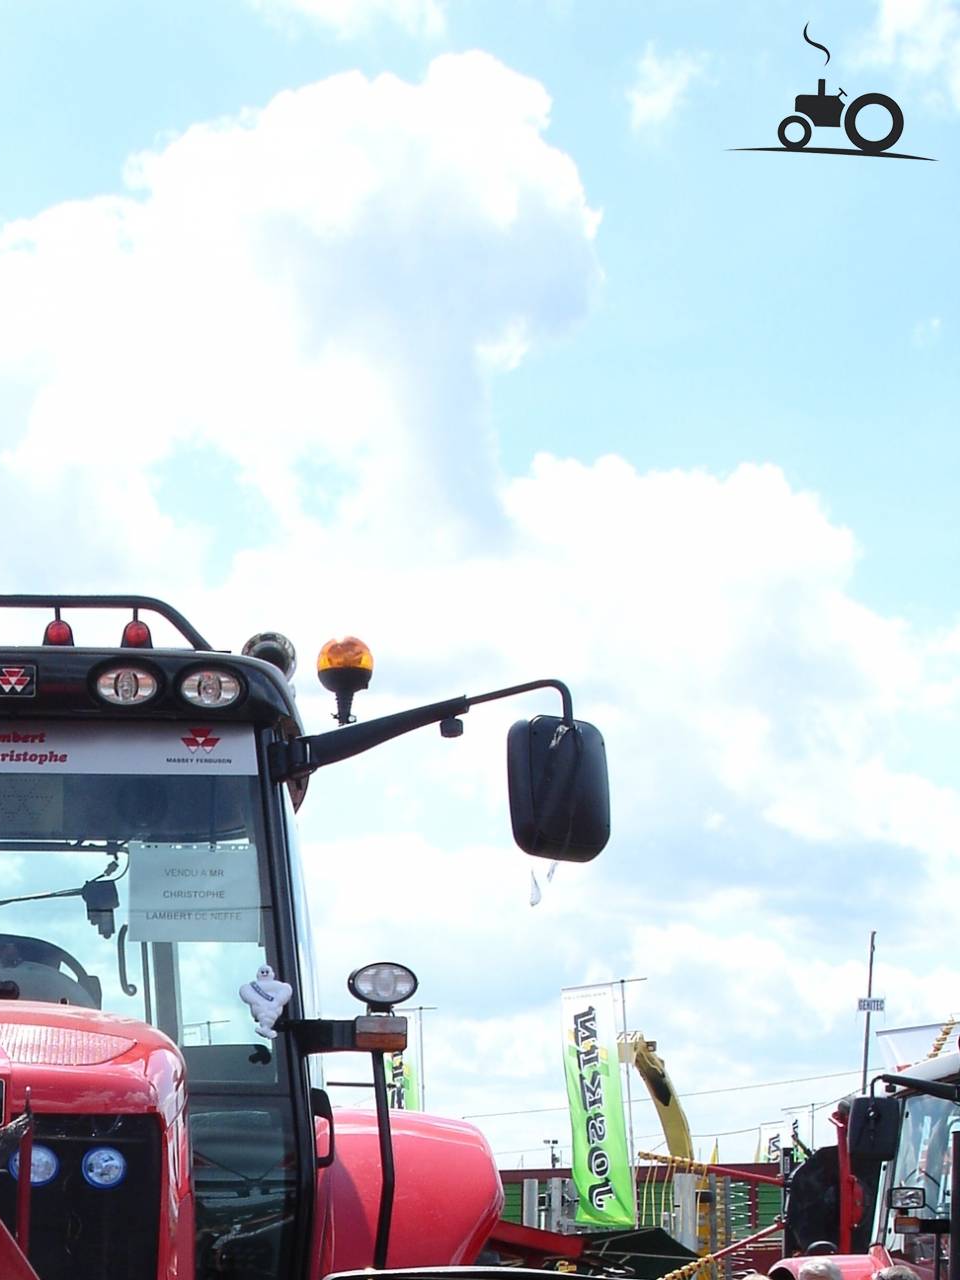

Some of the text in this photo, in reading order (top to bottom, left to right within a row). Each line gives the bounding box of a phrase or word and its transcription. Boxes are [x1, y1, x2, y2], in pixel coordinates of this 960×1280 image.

[164, 868, 199, 878] VENDU
[209, 869, 225, 878] MR
[162, 890, 225, 899] CHRISTOPHE
[145, 912, 193, 921] LAMBERT
[195, 912, 208, 921] DE
